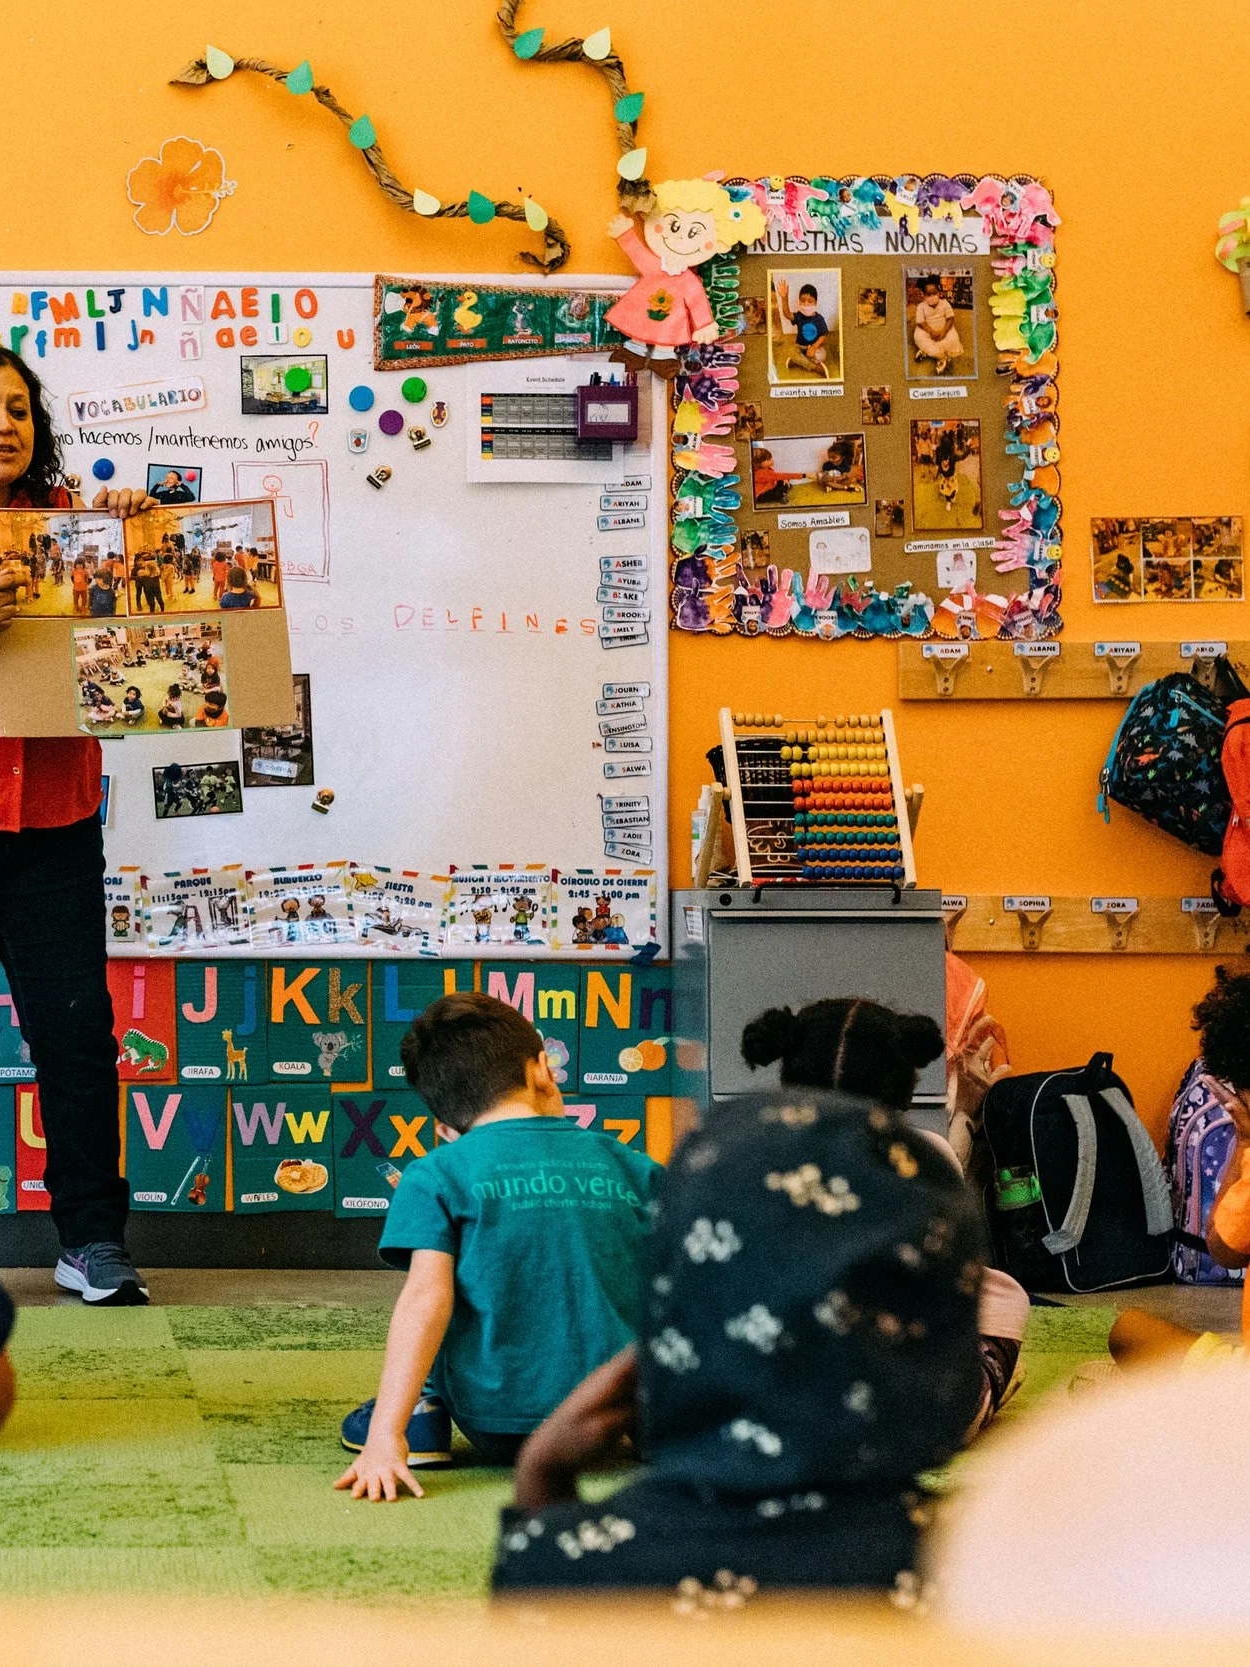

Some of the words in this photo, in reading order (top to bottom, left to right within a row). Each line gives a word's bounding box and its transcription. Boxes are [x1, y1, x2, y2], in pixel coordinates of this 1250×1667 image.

[754, 230, 863, 252] NUESTRAS
[886, 231, 978, 252] NORMAS
[406, 341, 421, 350] LEÓN
[459, 341, 474, 349] PATO
[508, 337, 538, 345] RATONCITO
[821, 388, 842, 396] mano
[74, 387, 202, 421] VOCABULARIO
[79, 427, 143, 446] hacemos
[613, 517, 640, 525] ALBANE
[780, 518, 807, 529] Somos
[810, 515, 845, 526] Amables
[906, 541, 949, 550] Caminamos
[615, 559, 643, 567] ASHER
[1029, 645, 1056, 653] ALBANE
[622, 765, 646, 773] SALWA
[611, 817, 649, 825] SEBASTIAN
[621, 848, 641, 858] ZORA
[174, 877, 211, 889] PARQUE
[384, 881, 414, 893] SIESTA
[602, 878, 615, 887] DE
[568, 890, 590, 899] 2:45
[625, 891, 640, 900] pm
[279, 1062, 306, 1071] KOALA
[187, 1067, 215, 1077] JIRAFA
[586, 1073, 624, 1083] NARANJA
[472, 1170, 567, 1199] mundo
[136, 1191, 163, 1202] VIOLÍN
[344, 1198, 387, 1209] XILÓFONO
